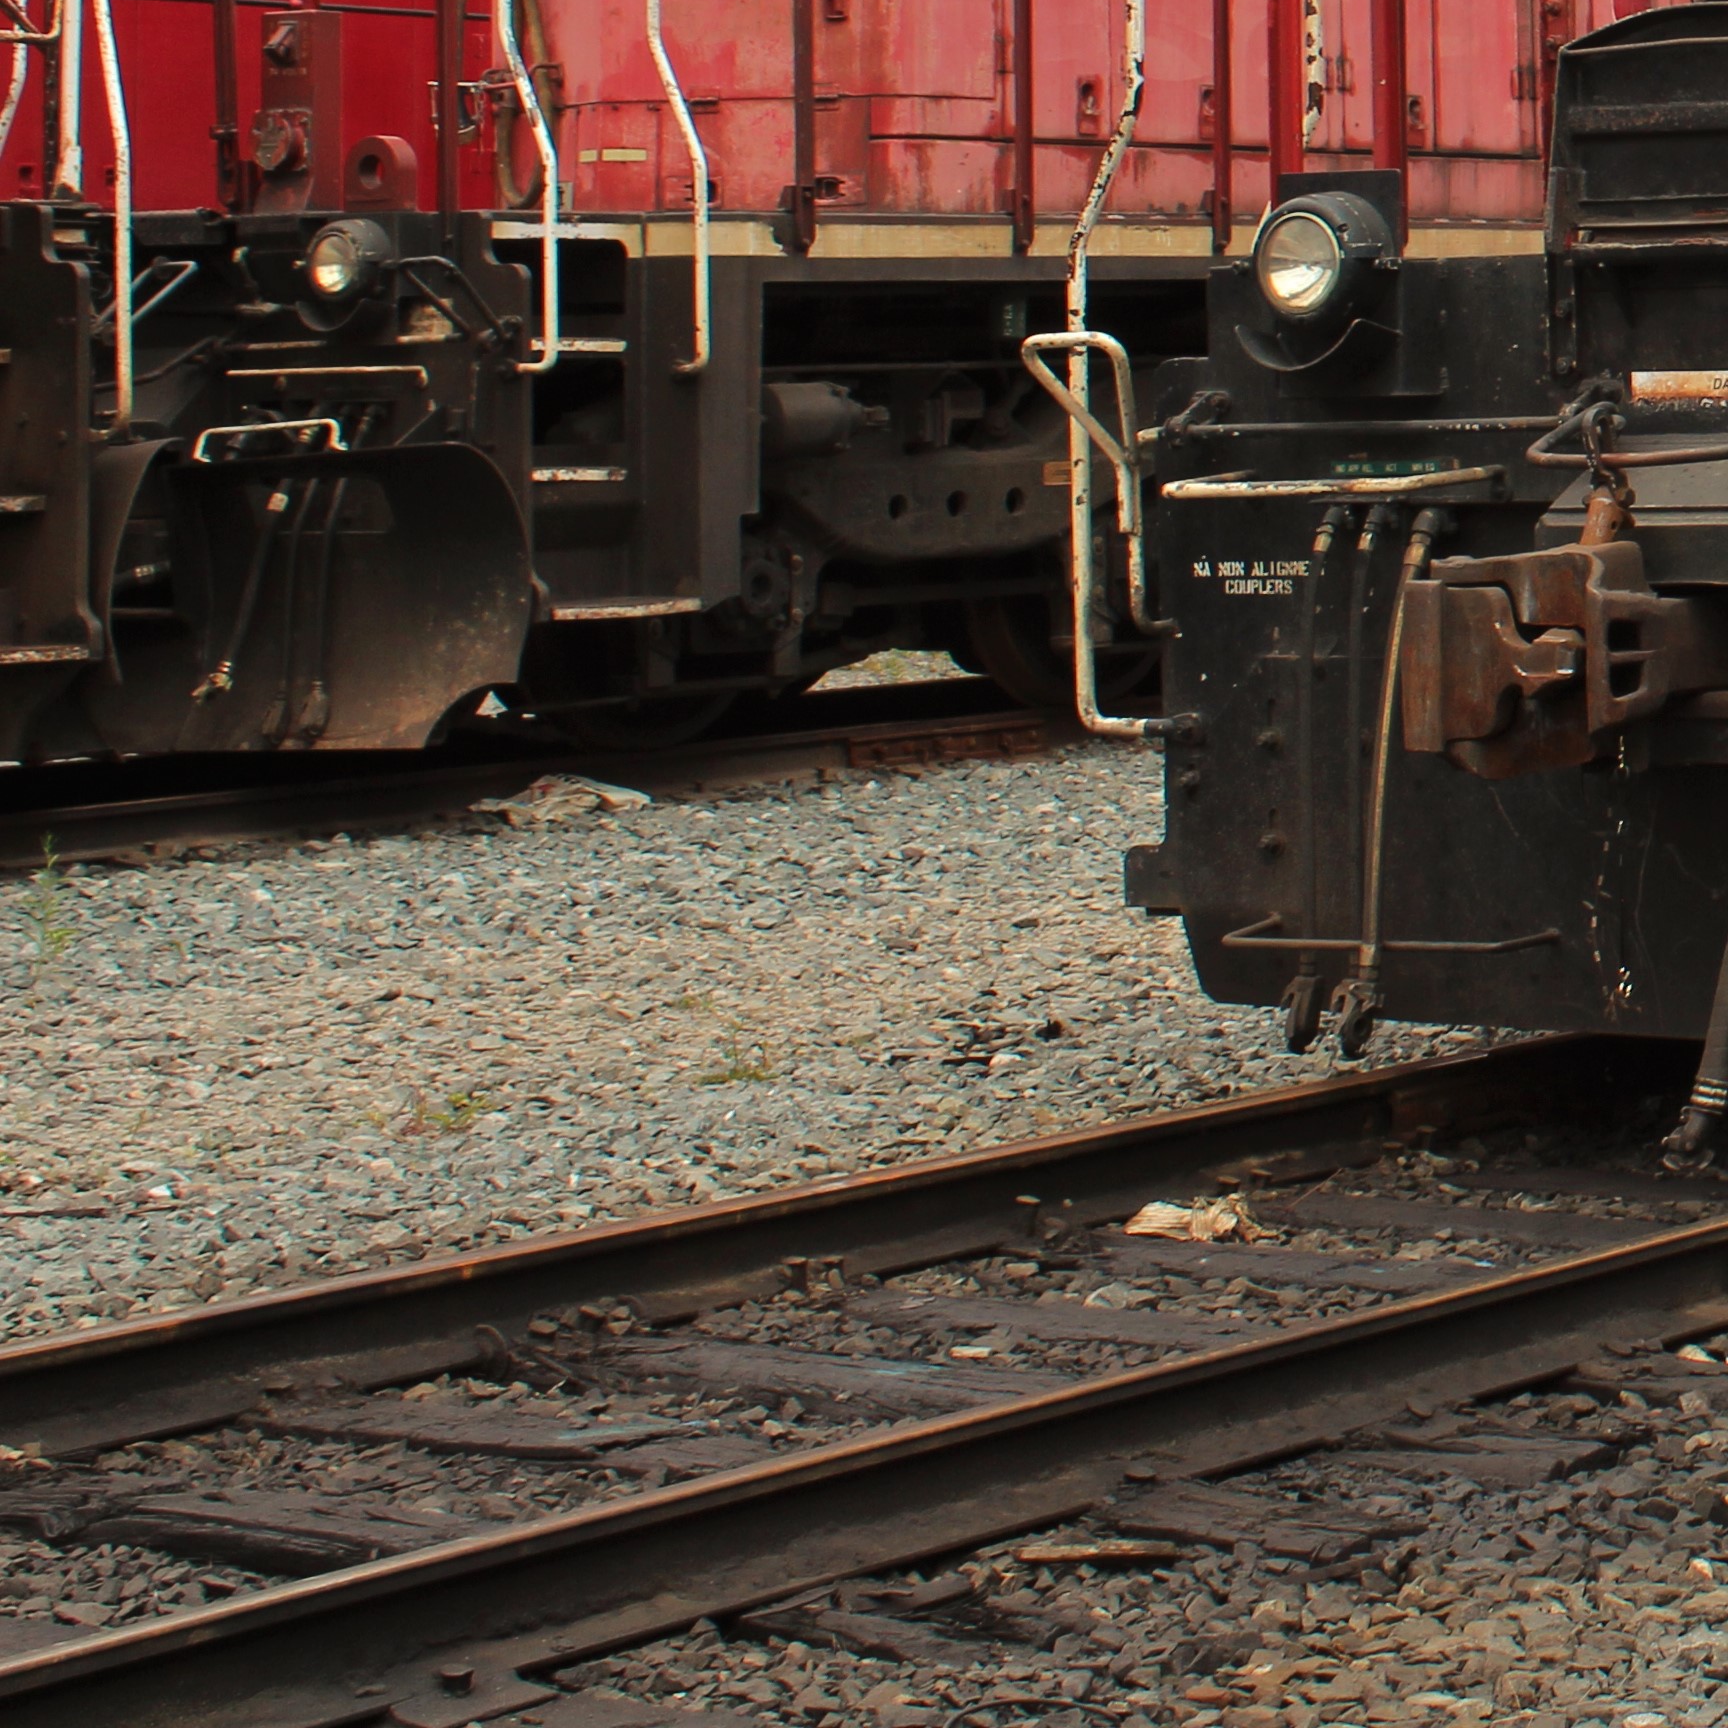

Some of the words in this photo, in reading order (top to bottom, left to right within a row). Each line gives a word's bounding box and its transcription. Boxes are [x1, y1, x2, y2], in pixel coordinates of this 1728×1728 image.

[1218, 561, 1245, 577] NON
[1251, 560, 1326, 577] ALIGNME
[1225, 579, 1294, 595] COUPLERS
